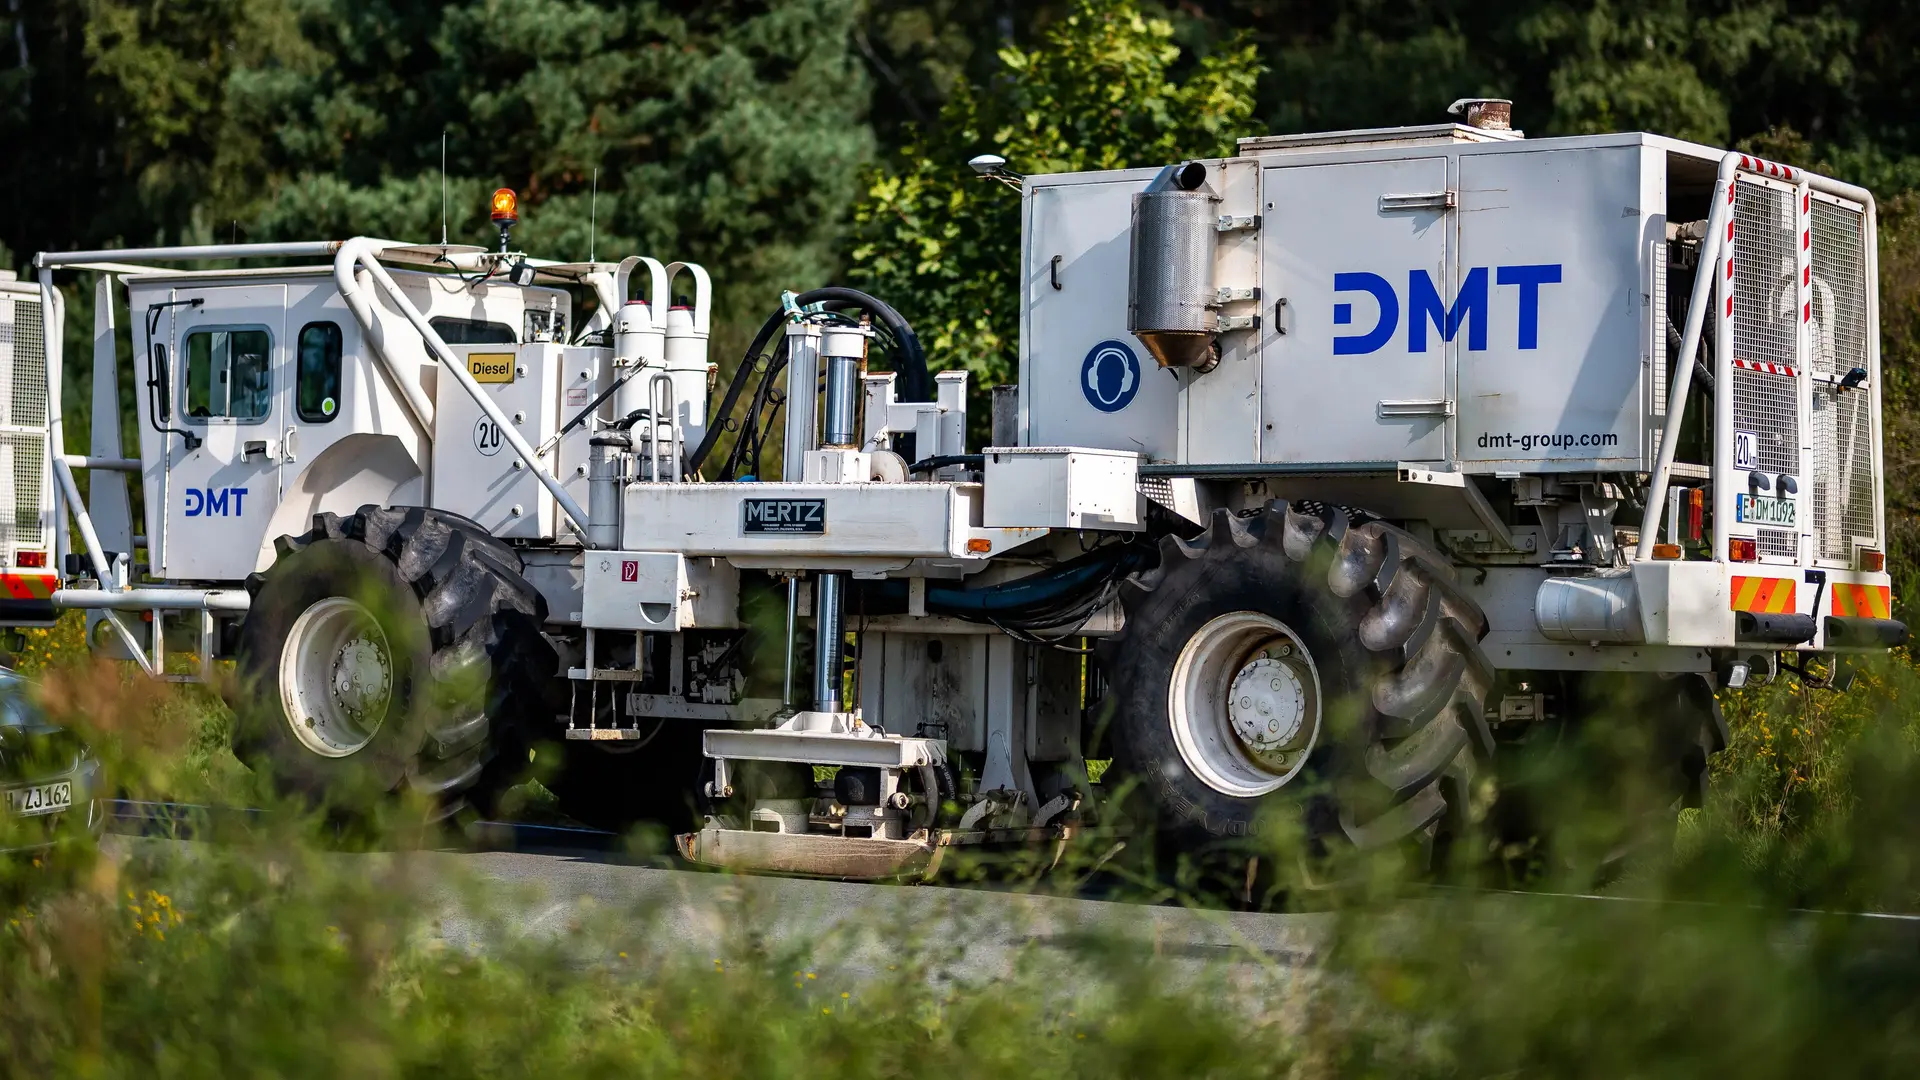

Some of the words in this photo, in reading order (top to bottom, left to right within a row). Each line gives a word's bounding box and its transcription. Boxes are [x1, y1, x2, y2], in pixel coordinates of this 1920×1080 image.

[1333, 264, 1562, 355] DMT
[473, 362, 509, 374] Diesel
[480, 422, 500, 448] 20
[1477, 432, 1618, 451] dmt-group.com
[1737, 434, 1749, 465] 20
[185, 488, 248, 516] DMT
[747, 501, 821, 522] MERTZ
[1743, 497, 1750, 519] E
[1804, 569, 1827, 646] 7
